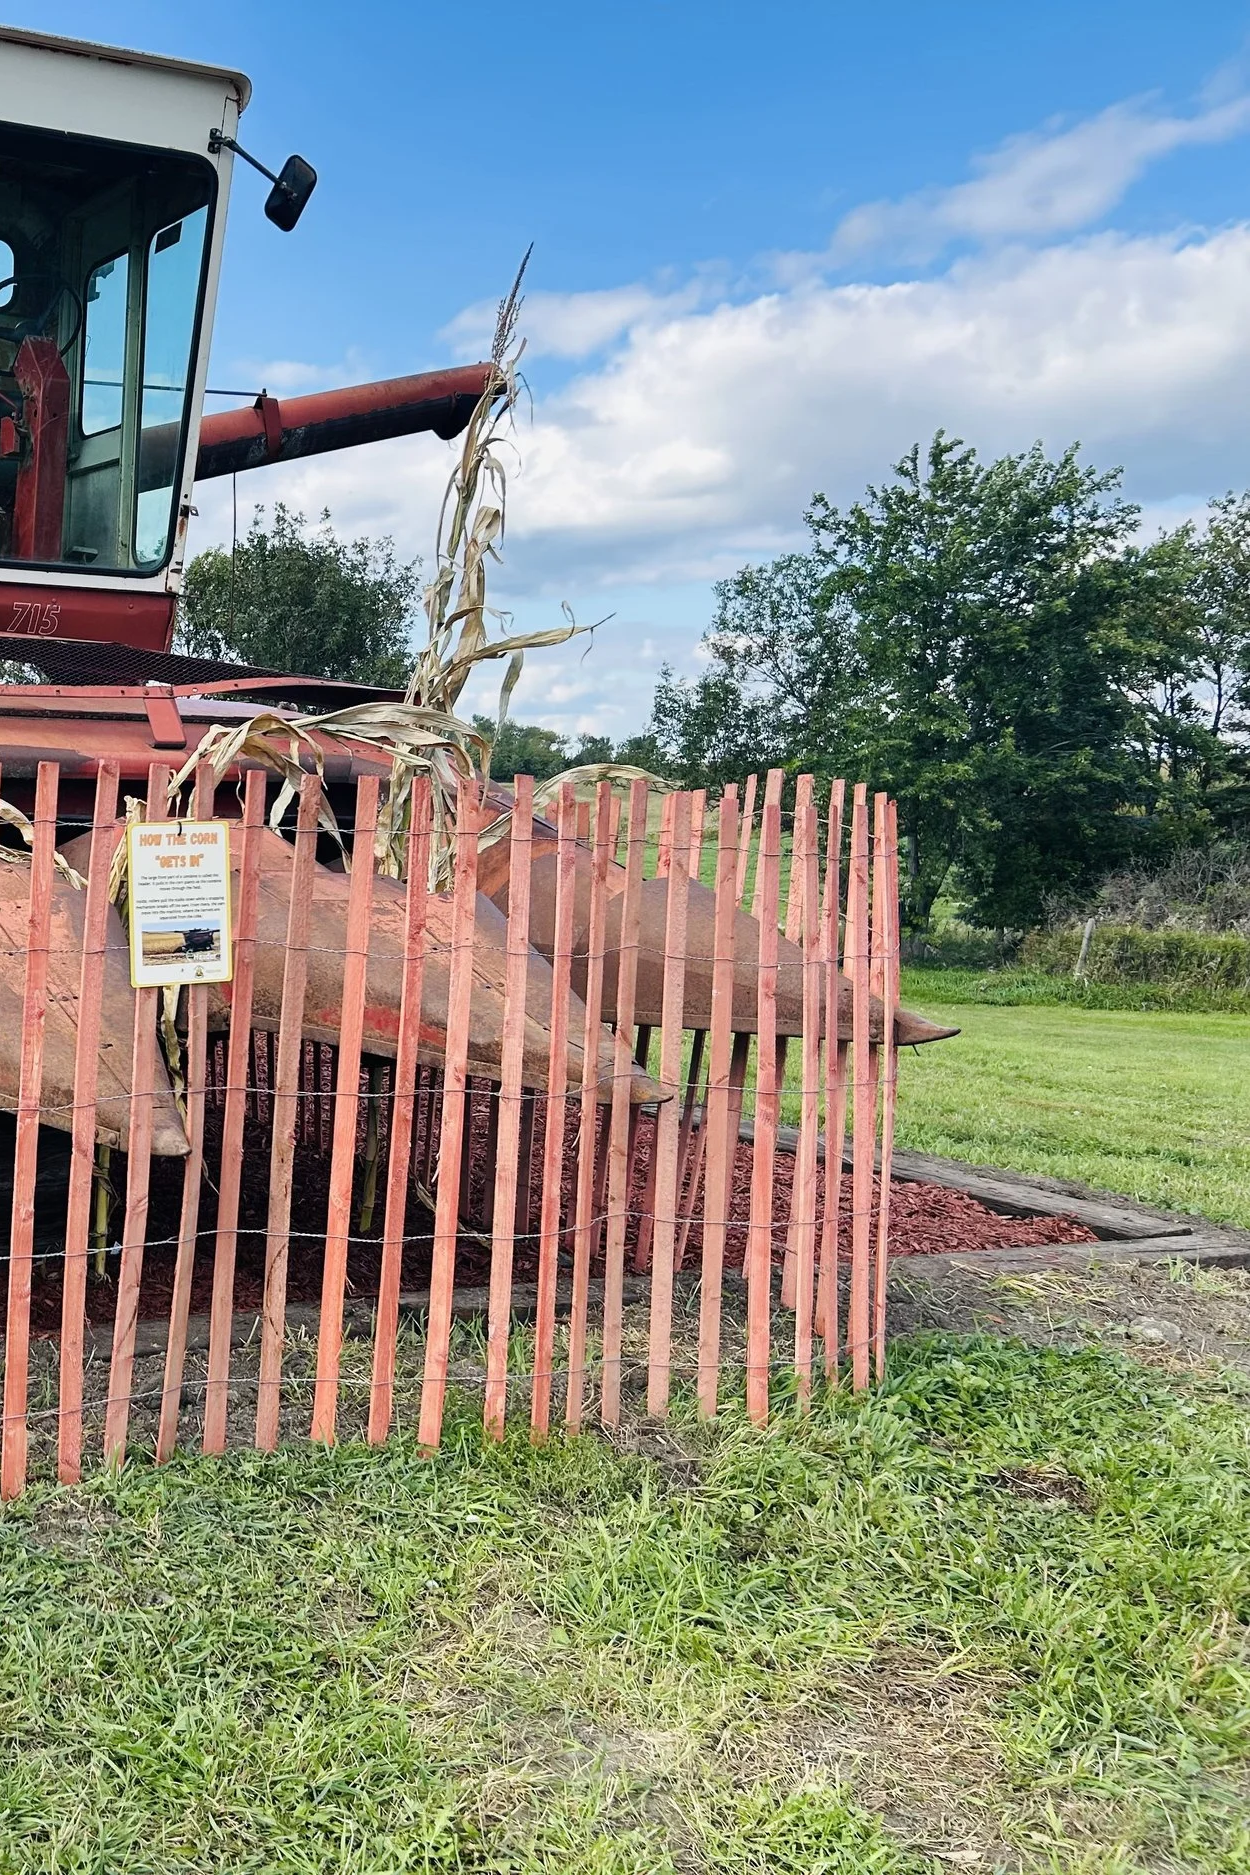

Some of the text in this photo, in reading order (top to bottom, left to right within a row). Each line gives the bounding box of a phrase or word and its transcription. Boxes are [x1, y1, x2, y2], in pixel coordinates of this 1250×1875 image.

[6, 601, 62, 636] 715
[139, 831, 218, 847] HOW THE CORN
